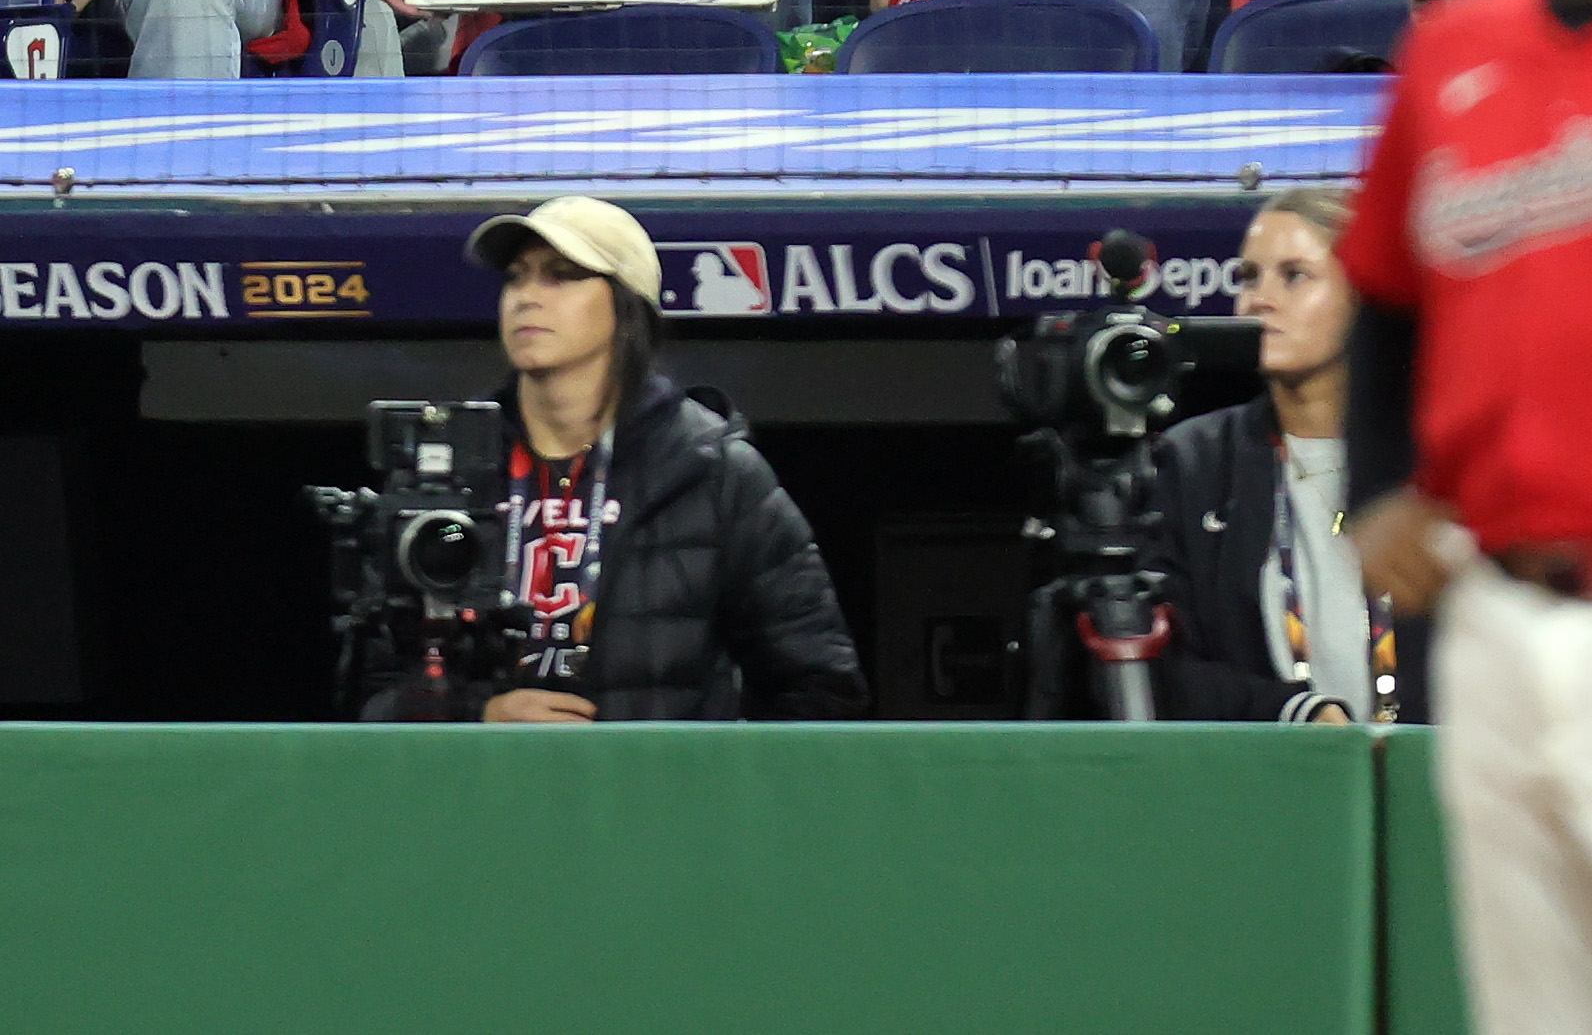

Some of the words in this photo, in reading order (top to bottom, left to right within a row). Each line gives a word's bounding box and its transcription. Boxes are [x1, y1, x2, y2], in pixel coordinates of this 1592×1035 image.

[0, 263, 230, 318] EASON
[241, 273, 371, 305] 2024
[778, 243, 976, 312] ALCS
[520, 532, 586, 619] C
